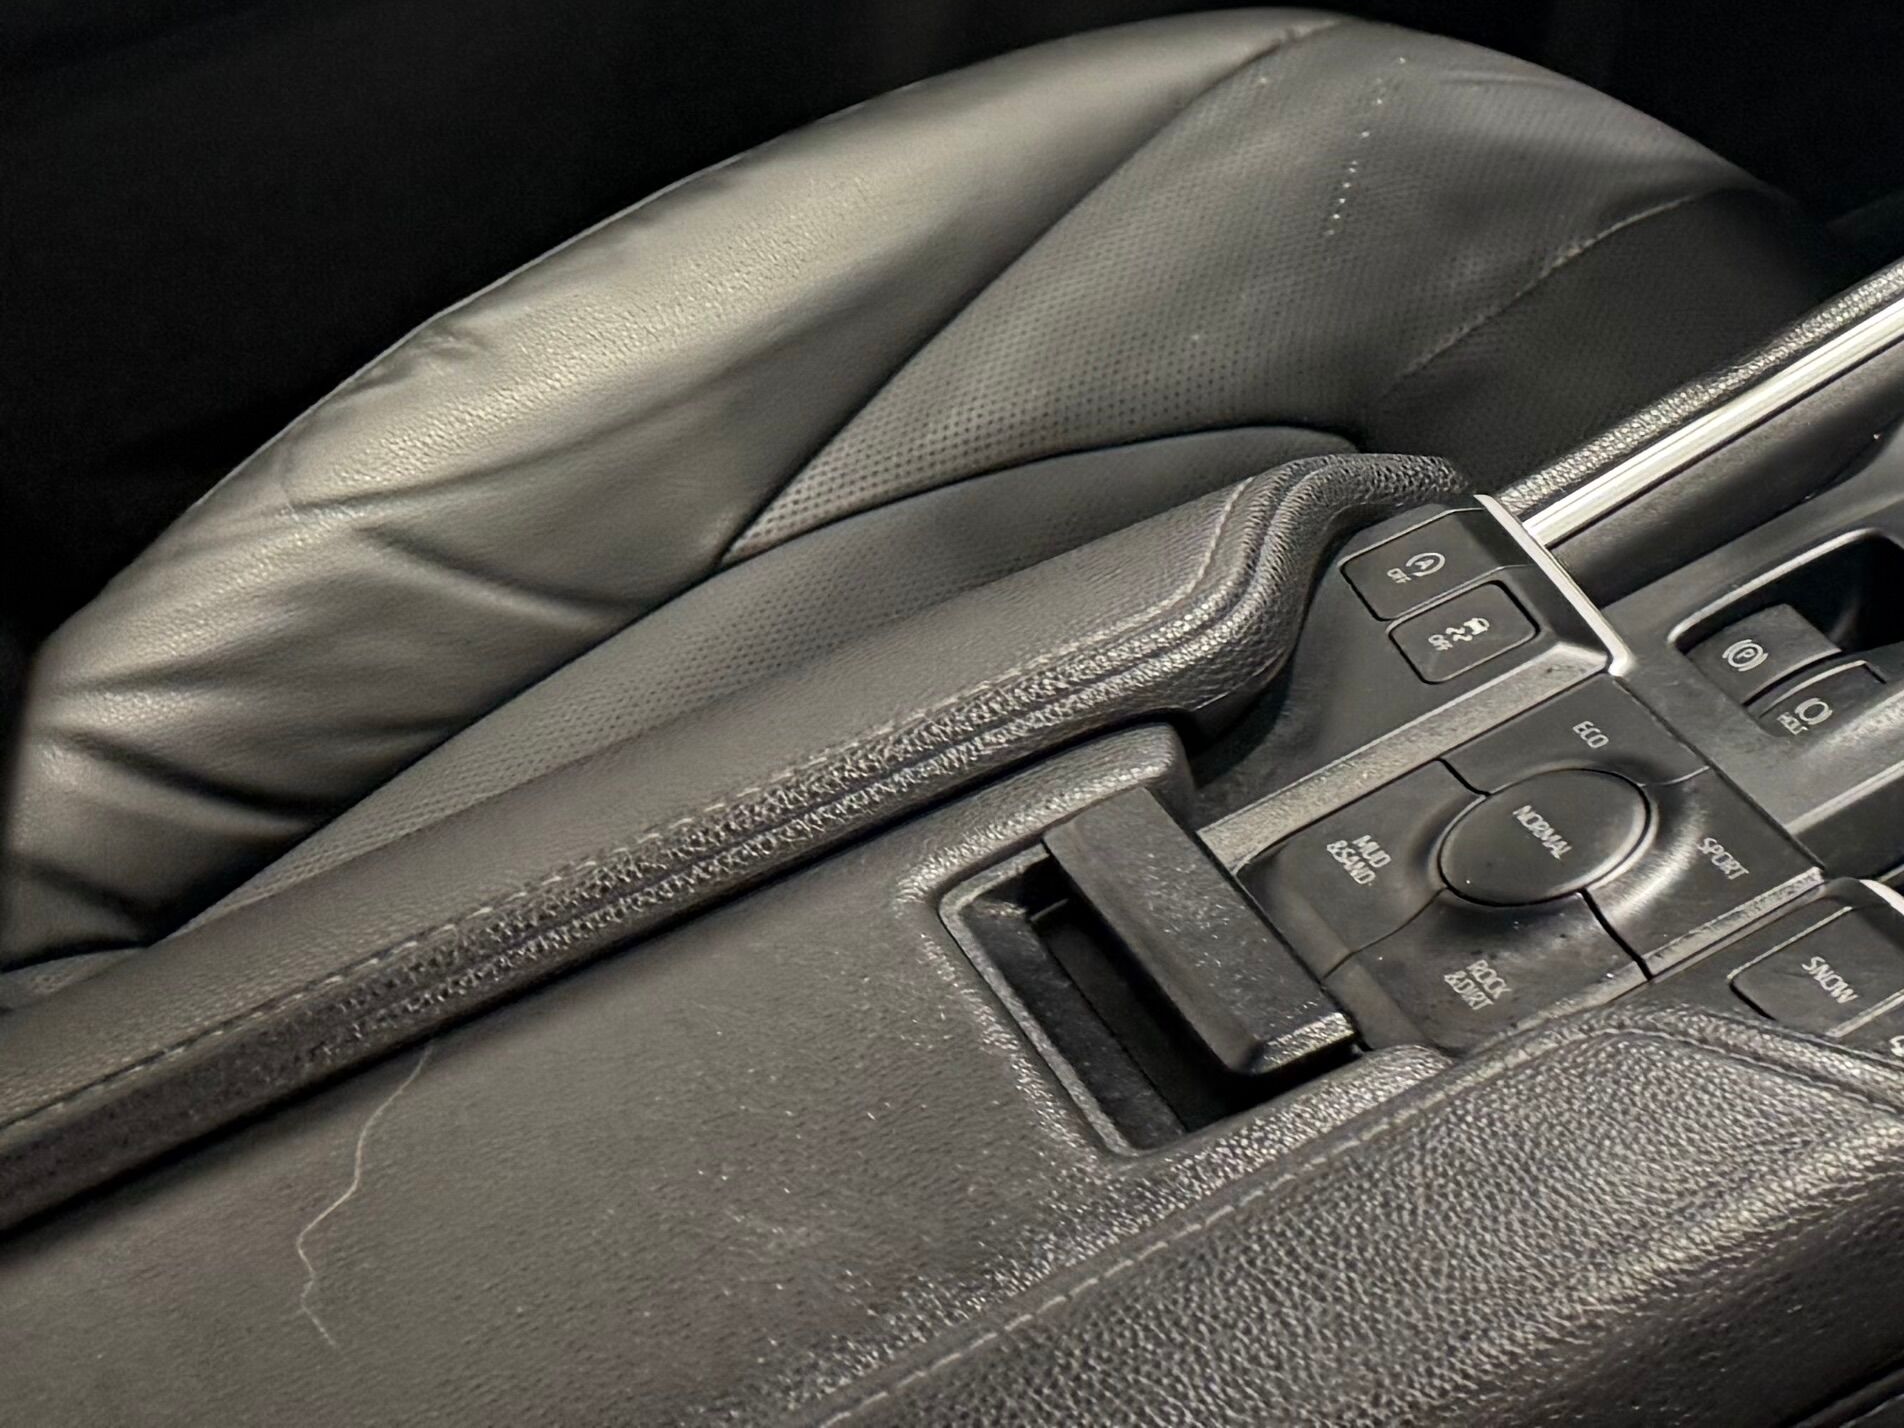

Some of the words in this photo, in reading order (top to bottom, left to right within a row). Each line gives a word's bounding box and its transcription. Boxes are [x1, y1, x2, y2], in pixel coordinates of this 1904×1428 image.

[1572, 720, 1609, 749] ECO
[1352, 834, 1392, 870] MUD
[1512, 804, 1574, 861] NORMAL
[1698, 836, 1750, 881] SPORT
[1466, 959, 1511, 1000] ROCK
[1802, 955, 1859, 1004] SNOW
